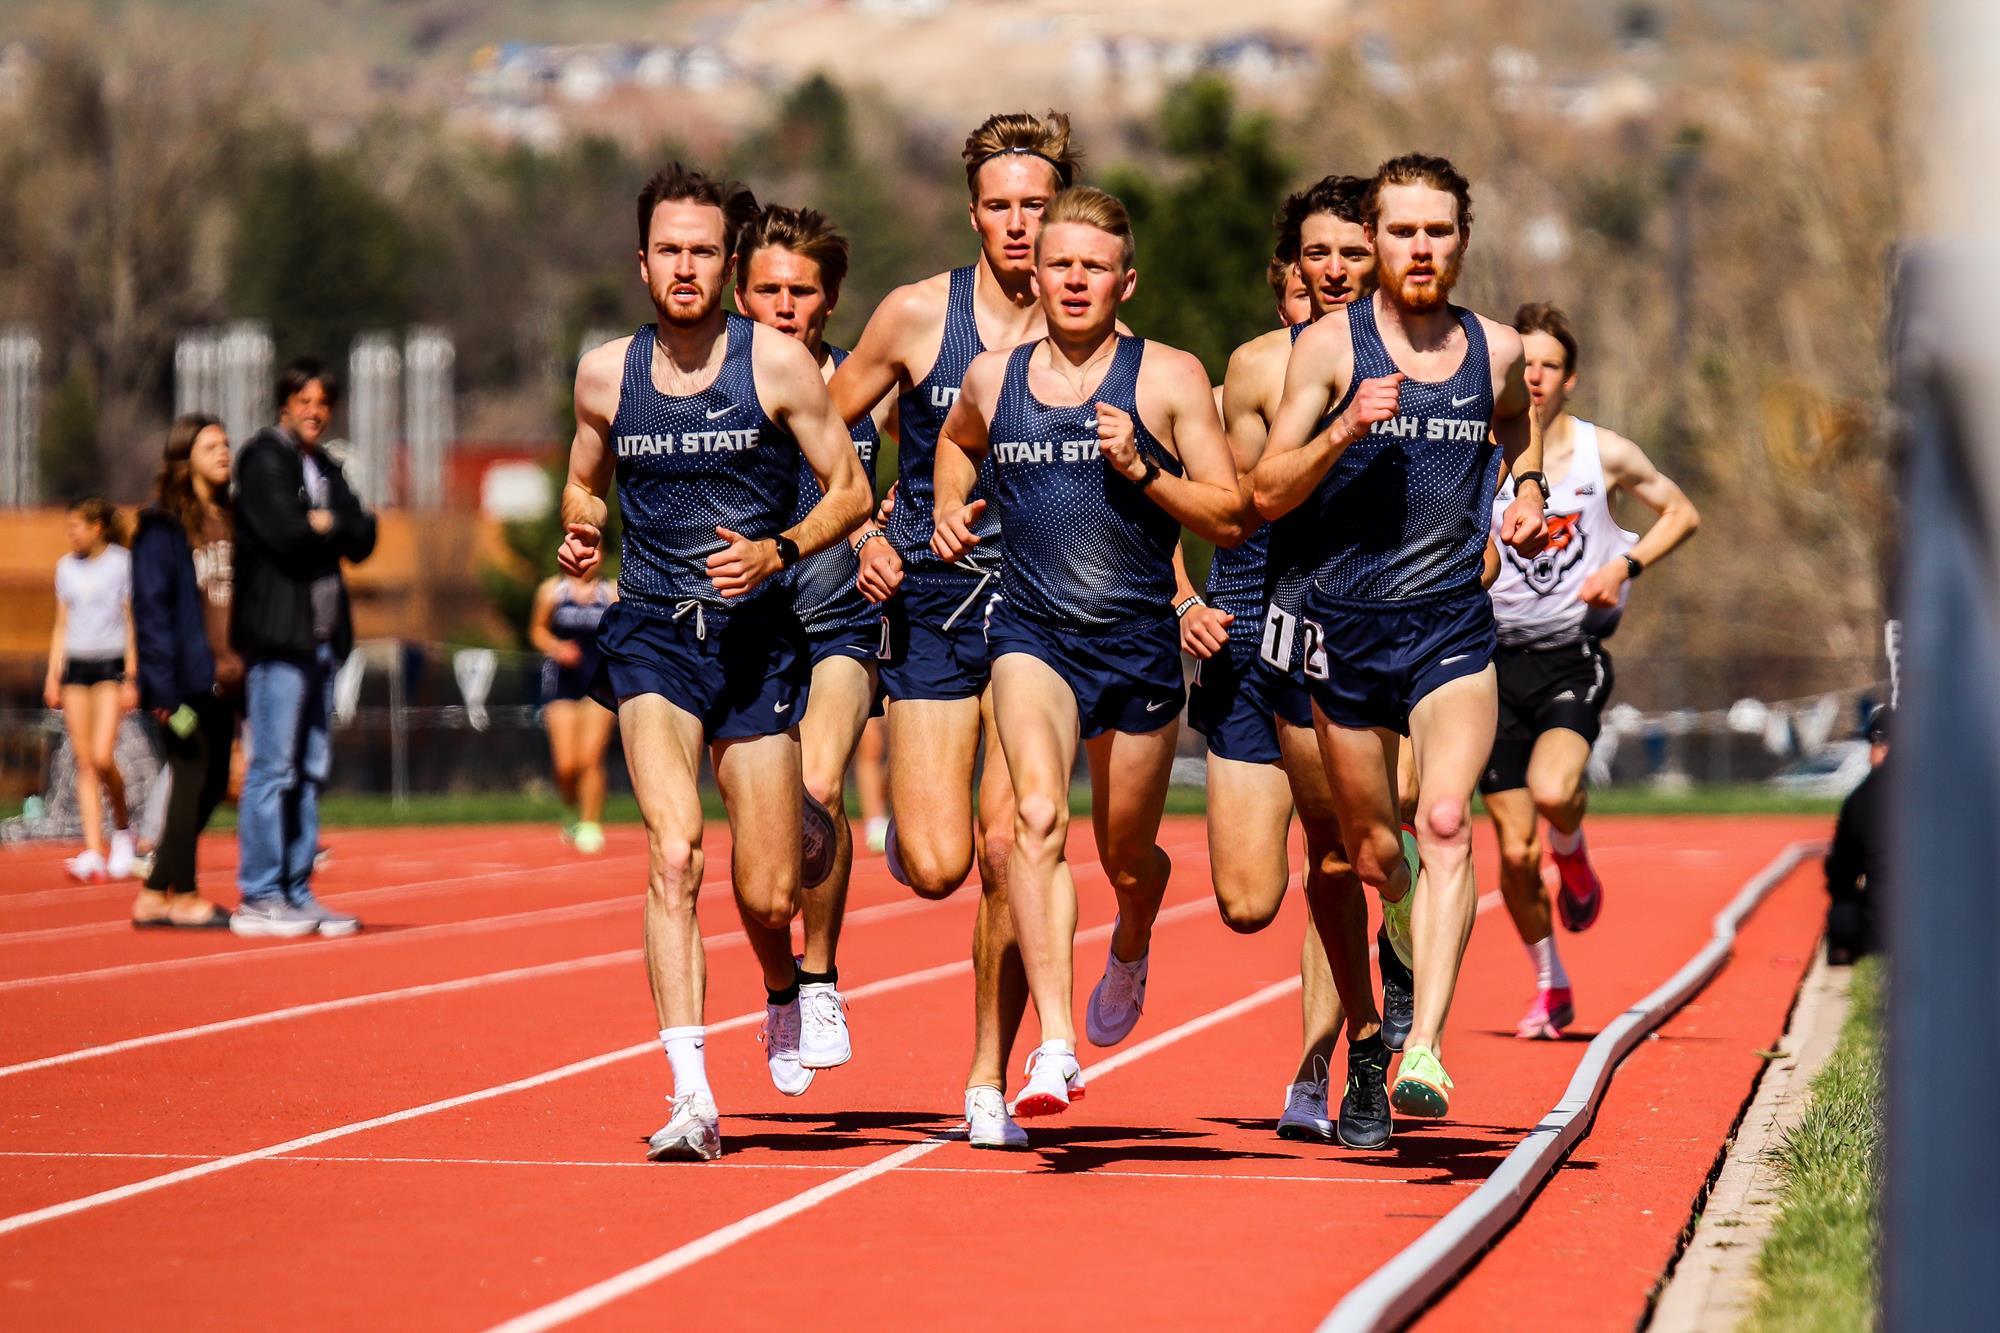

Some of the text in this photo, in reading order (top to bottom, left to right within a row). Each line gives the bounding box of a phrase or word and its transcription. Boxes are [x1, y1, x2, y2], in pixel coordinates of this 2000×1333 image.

[931, 385, 961, 407] UT
[1426, 417, 1488, 441] STATE
[617, 428, 760, 457] UTAH STATE
[994, 439, 1101, 463] UTAH STA
[1271, 613, 1285, 662] 1
[1303, 621, 1323, 675] 2
